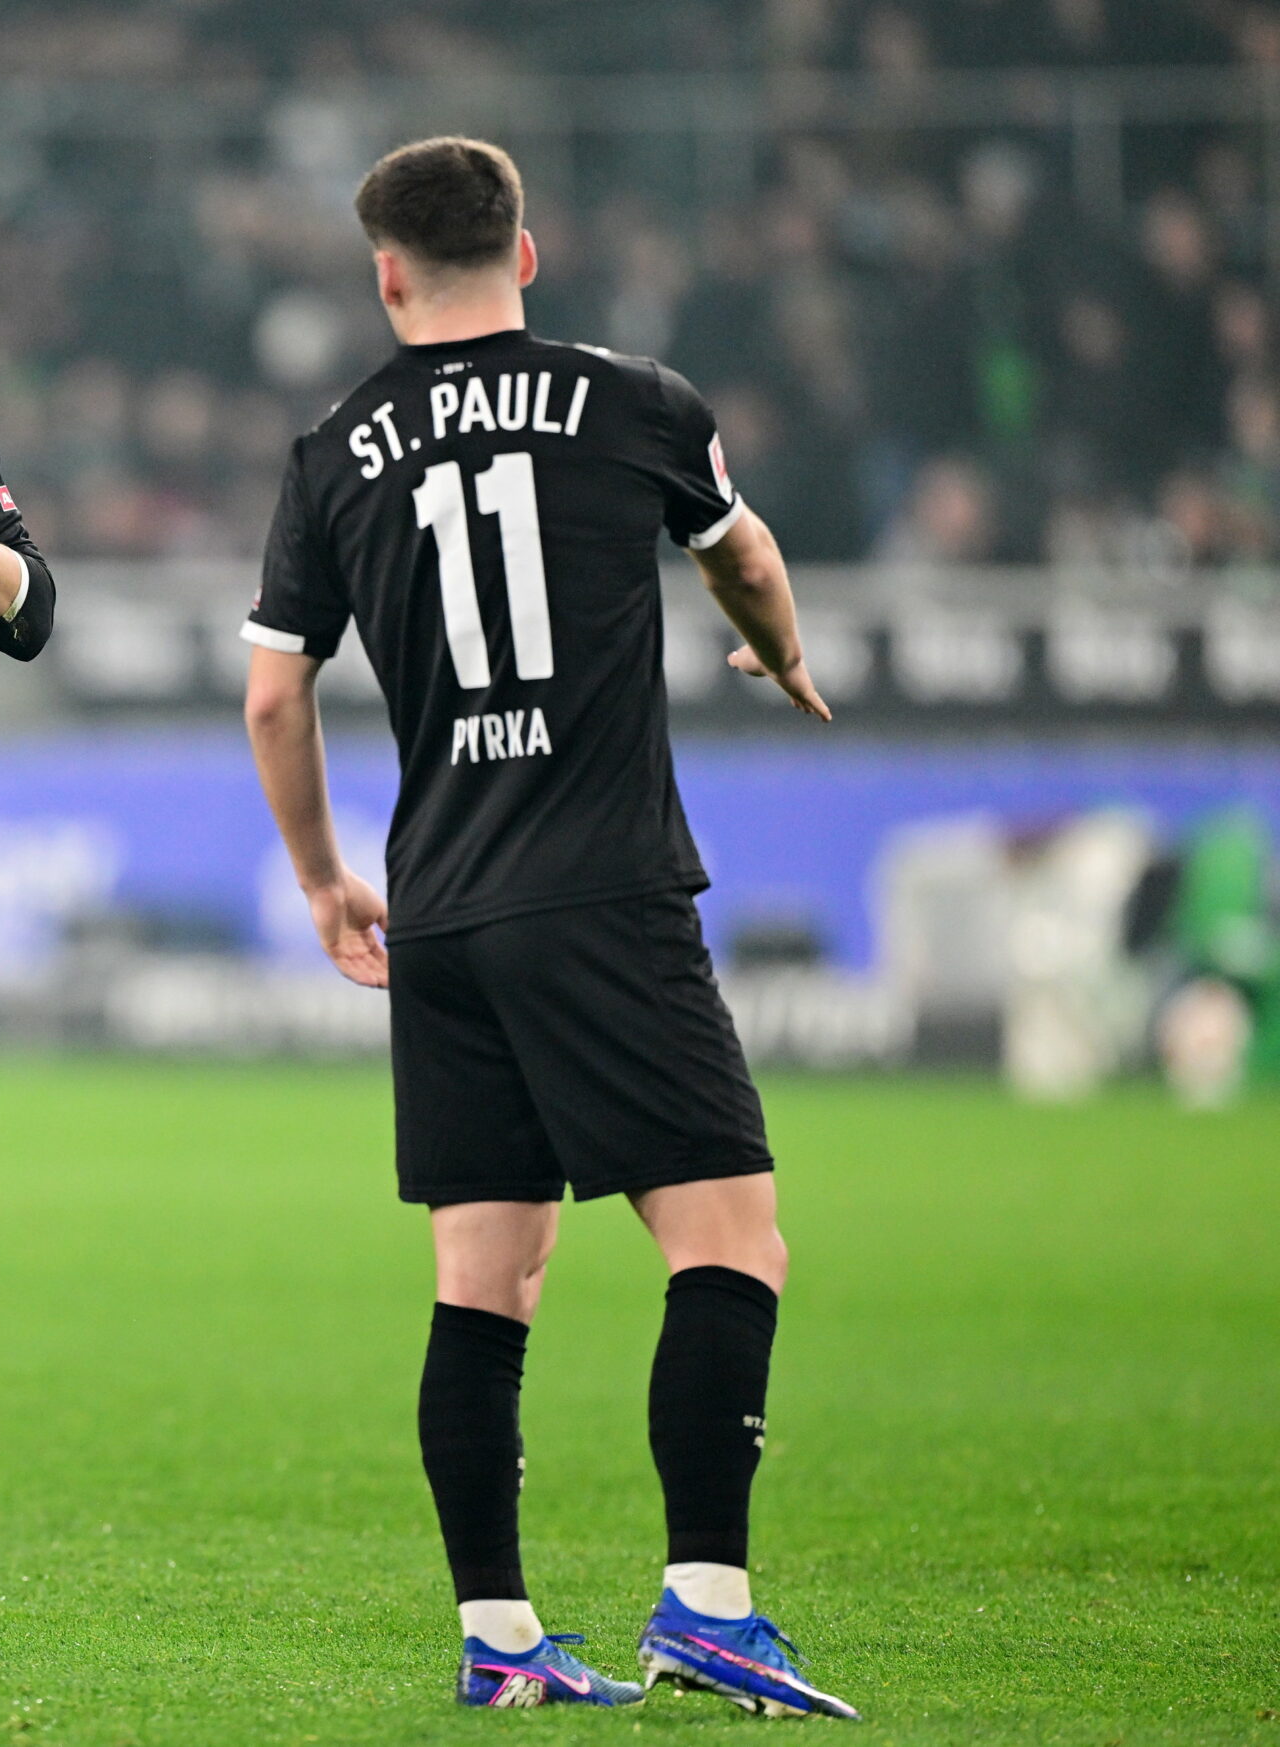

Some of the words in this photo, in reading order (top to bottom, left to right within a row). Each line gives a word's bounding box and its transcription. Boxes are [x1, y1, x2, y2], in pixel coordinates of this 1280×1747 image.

[348, 401, 422, 480] ST.
[429, 371, 591, 440] PAULI
[412, 451, 554, 689] 11
[451, 707, 552, 765] PYRKA
